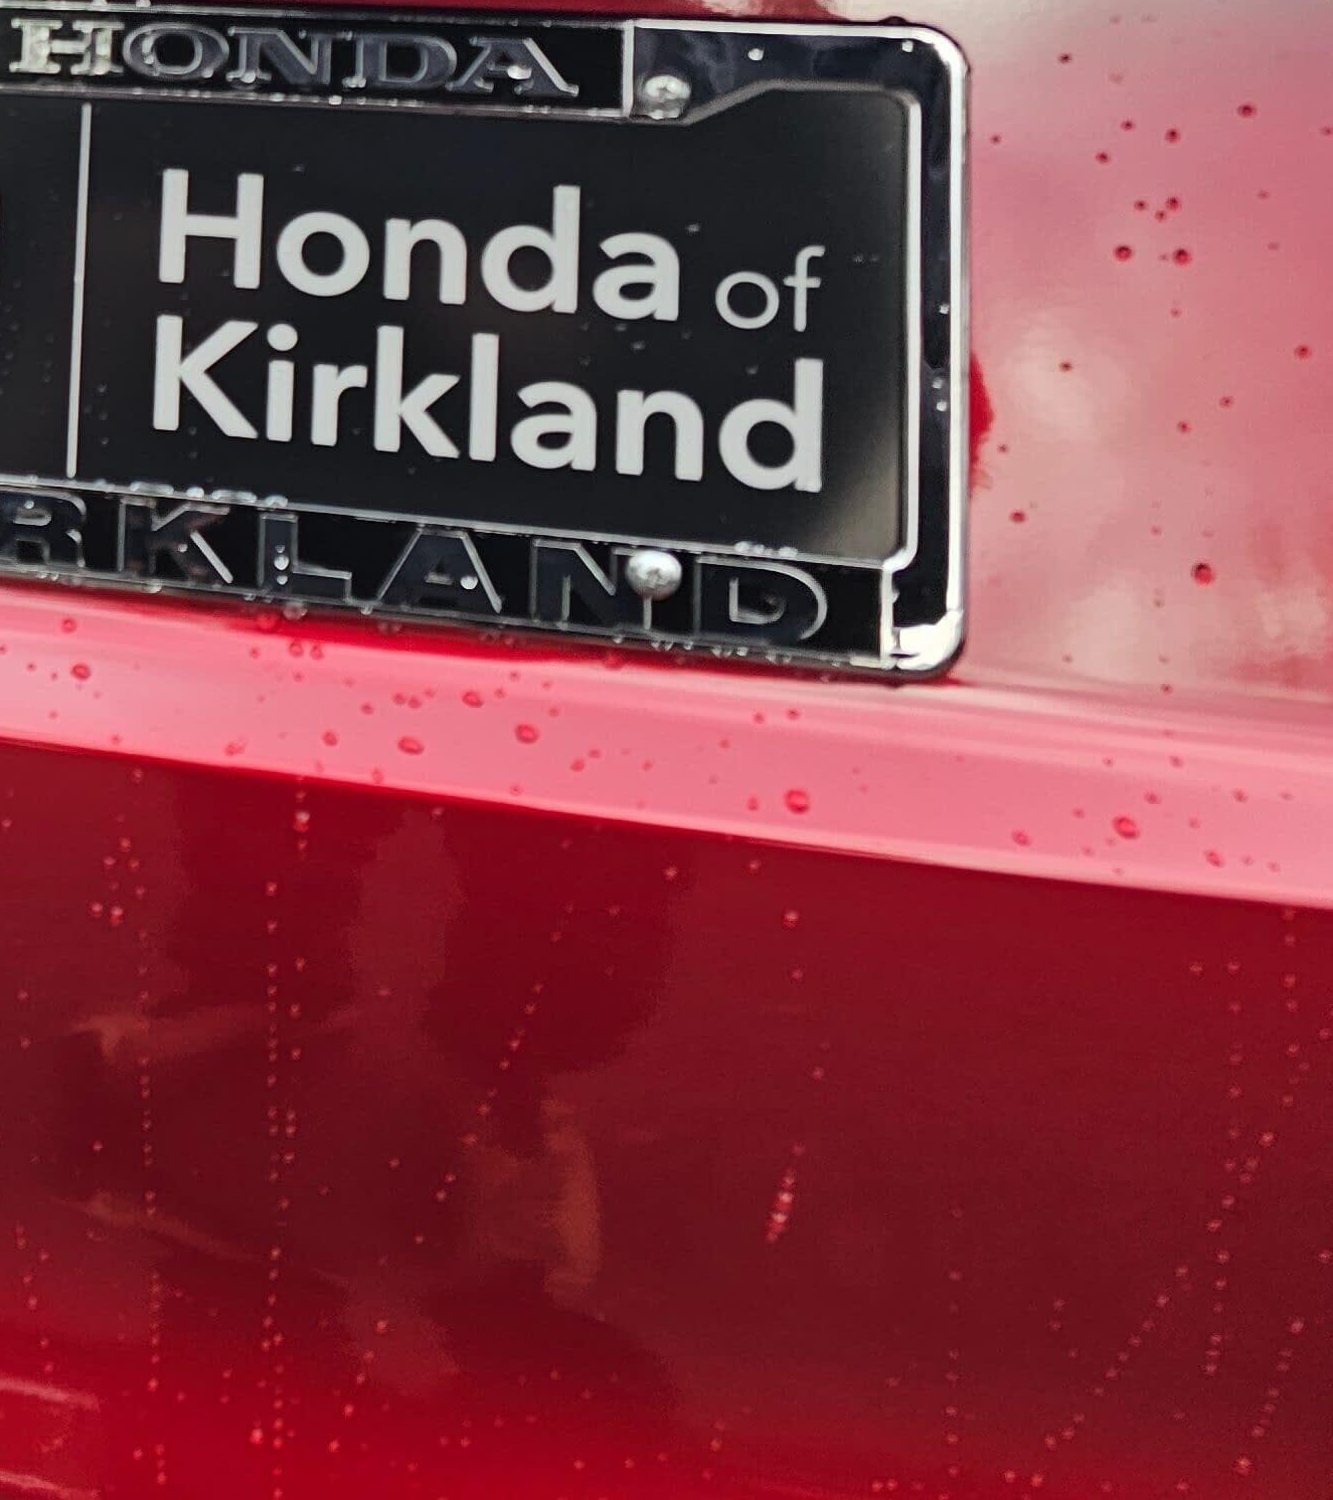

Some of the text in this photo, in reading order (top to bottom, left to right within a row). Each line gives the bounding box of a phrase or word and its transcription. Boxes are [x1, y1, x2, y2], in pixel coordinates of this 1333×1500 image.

[8, 17, 579, 96] HONDA
[158, 167, 825, 333] Honda of
[151, 314, 825, 494] Kirkland
